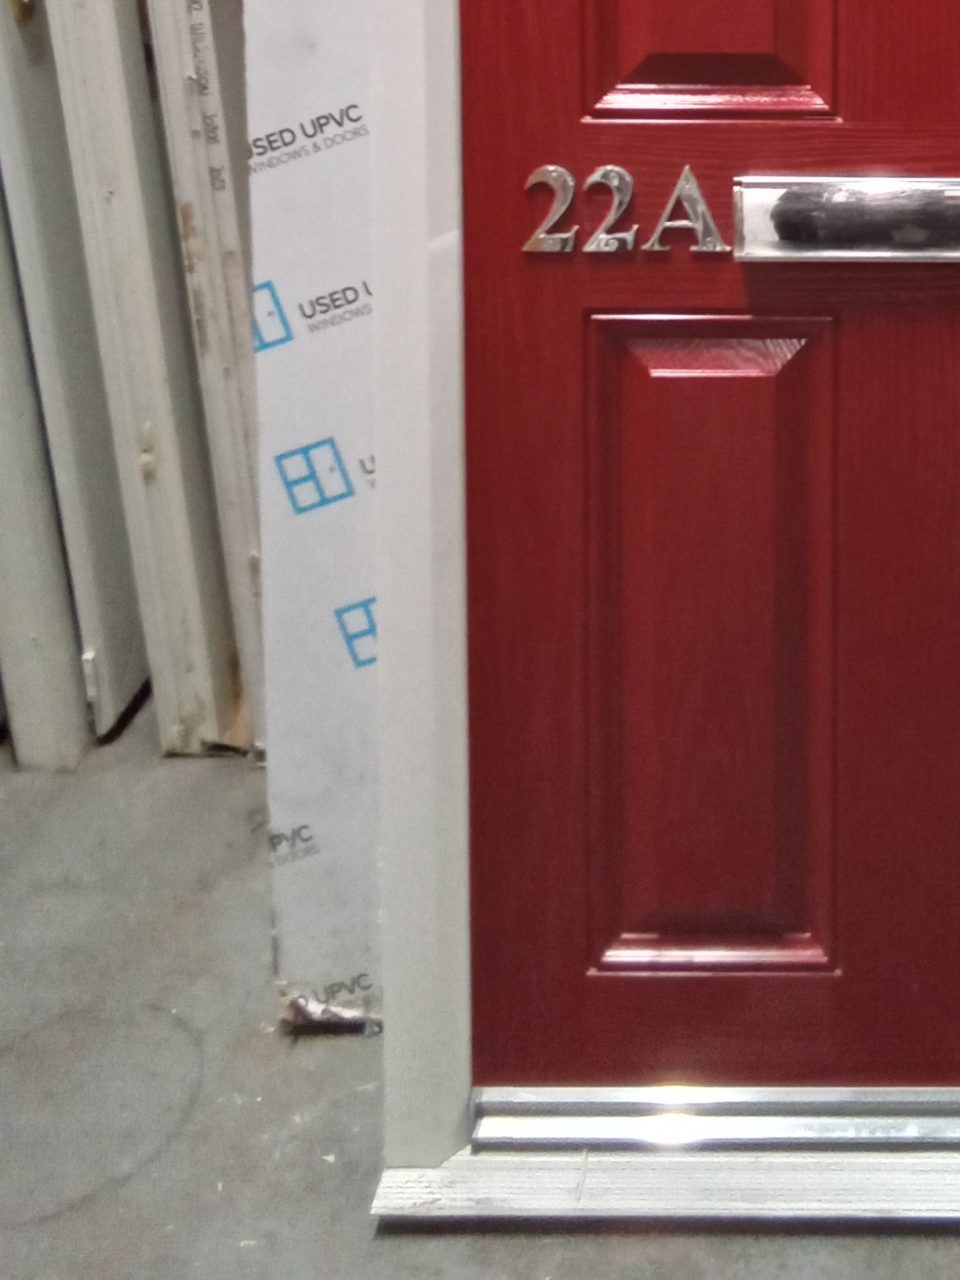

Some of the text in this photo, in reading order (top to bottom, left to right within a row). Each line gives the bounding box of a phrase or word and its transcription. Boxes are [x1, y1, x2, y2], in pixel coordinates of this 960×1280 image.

[252, 104, 363, 157] SED UPVC
[323, 124, 370, 150] DOORS
[521, 164, 732, 253] 22A
[298, 287, 359, 320] USED
[269, 825, 313, 853] PVC
